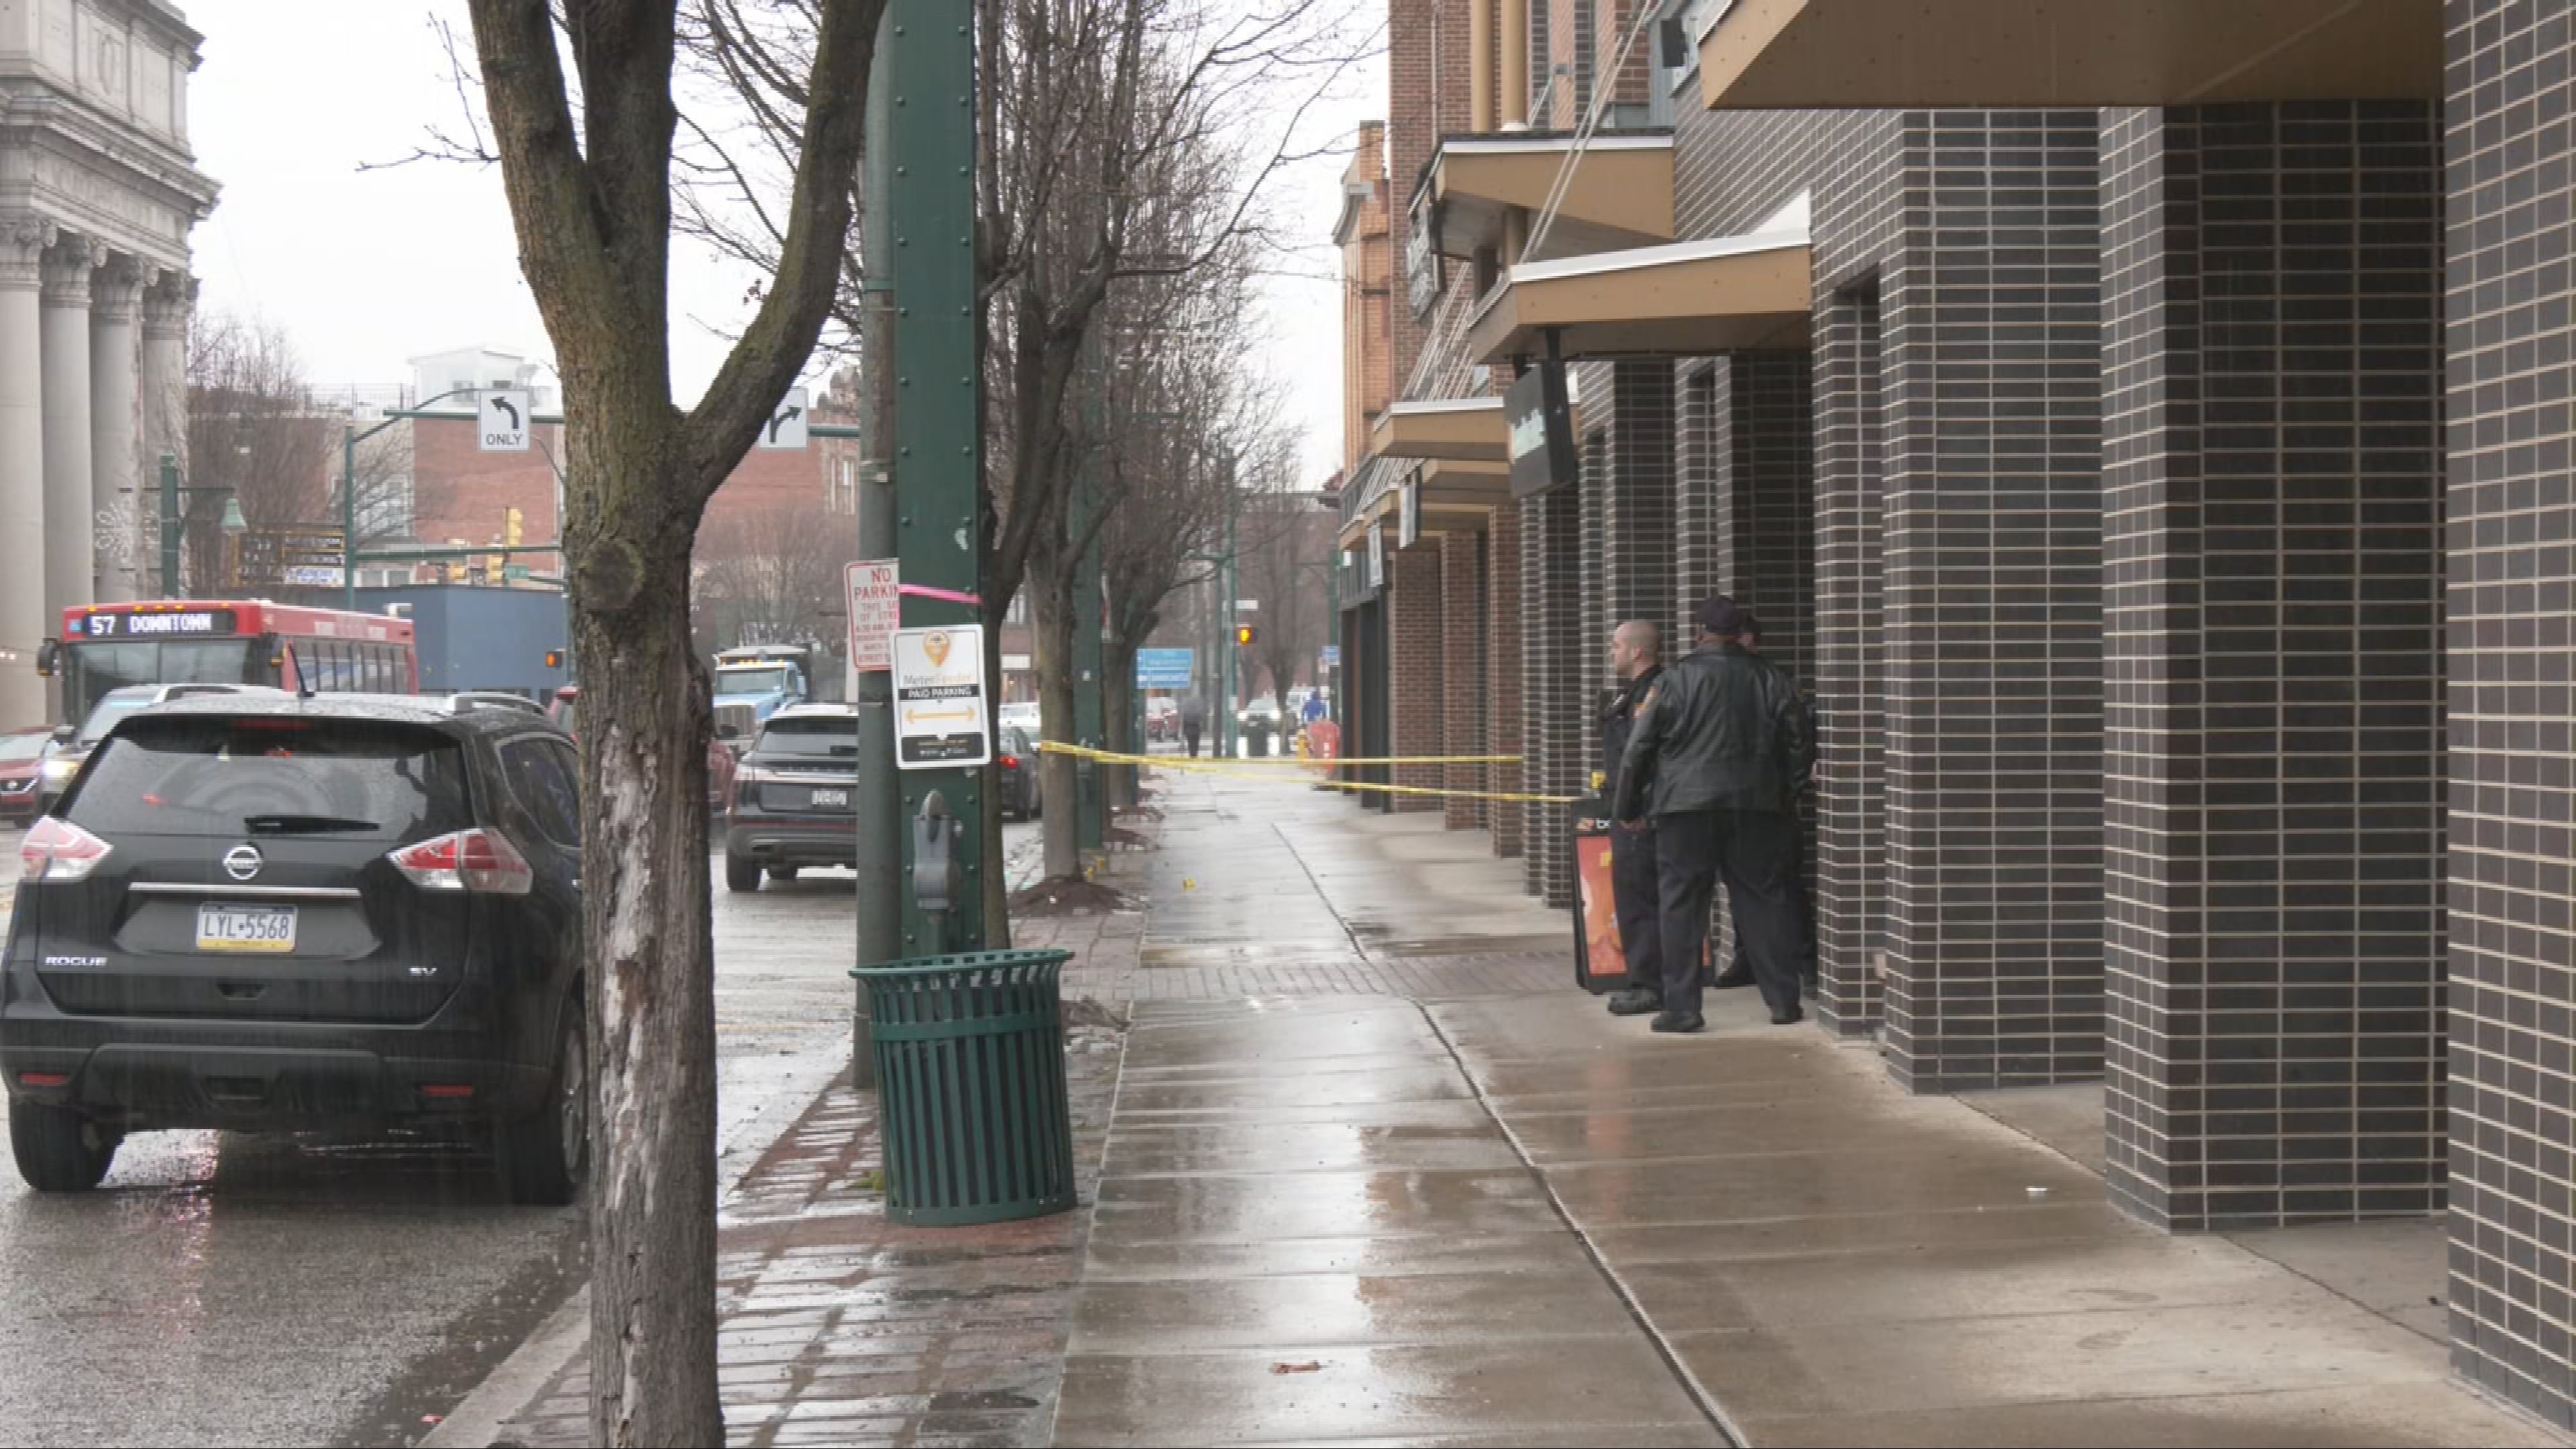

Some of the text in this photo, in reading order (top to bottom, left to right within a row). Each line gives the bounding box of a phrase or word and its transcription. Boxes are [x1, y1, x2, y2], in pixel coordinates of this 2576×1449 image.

[486, 433, 523, 445] ONLY
[871, 568, 892, 582] NO
[853, 584, 899, 600] PARKIN
[89, 613, 213, 635] 57 DOWNTOWN
[908, 686, 972, 698] PAID PARKING
[44, 956, 108, 967] ROGUE
